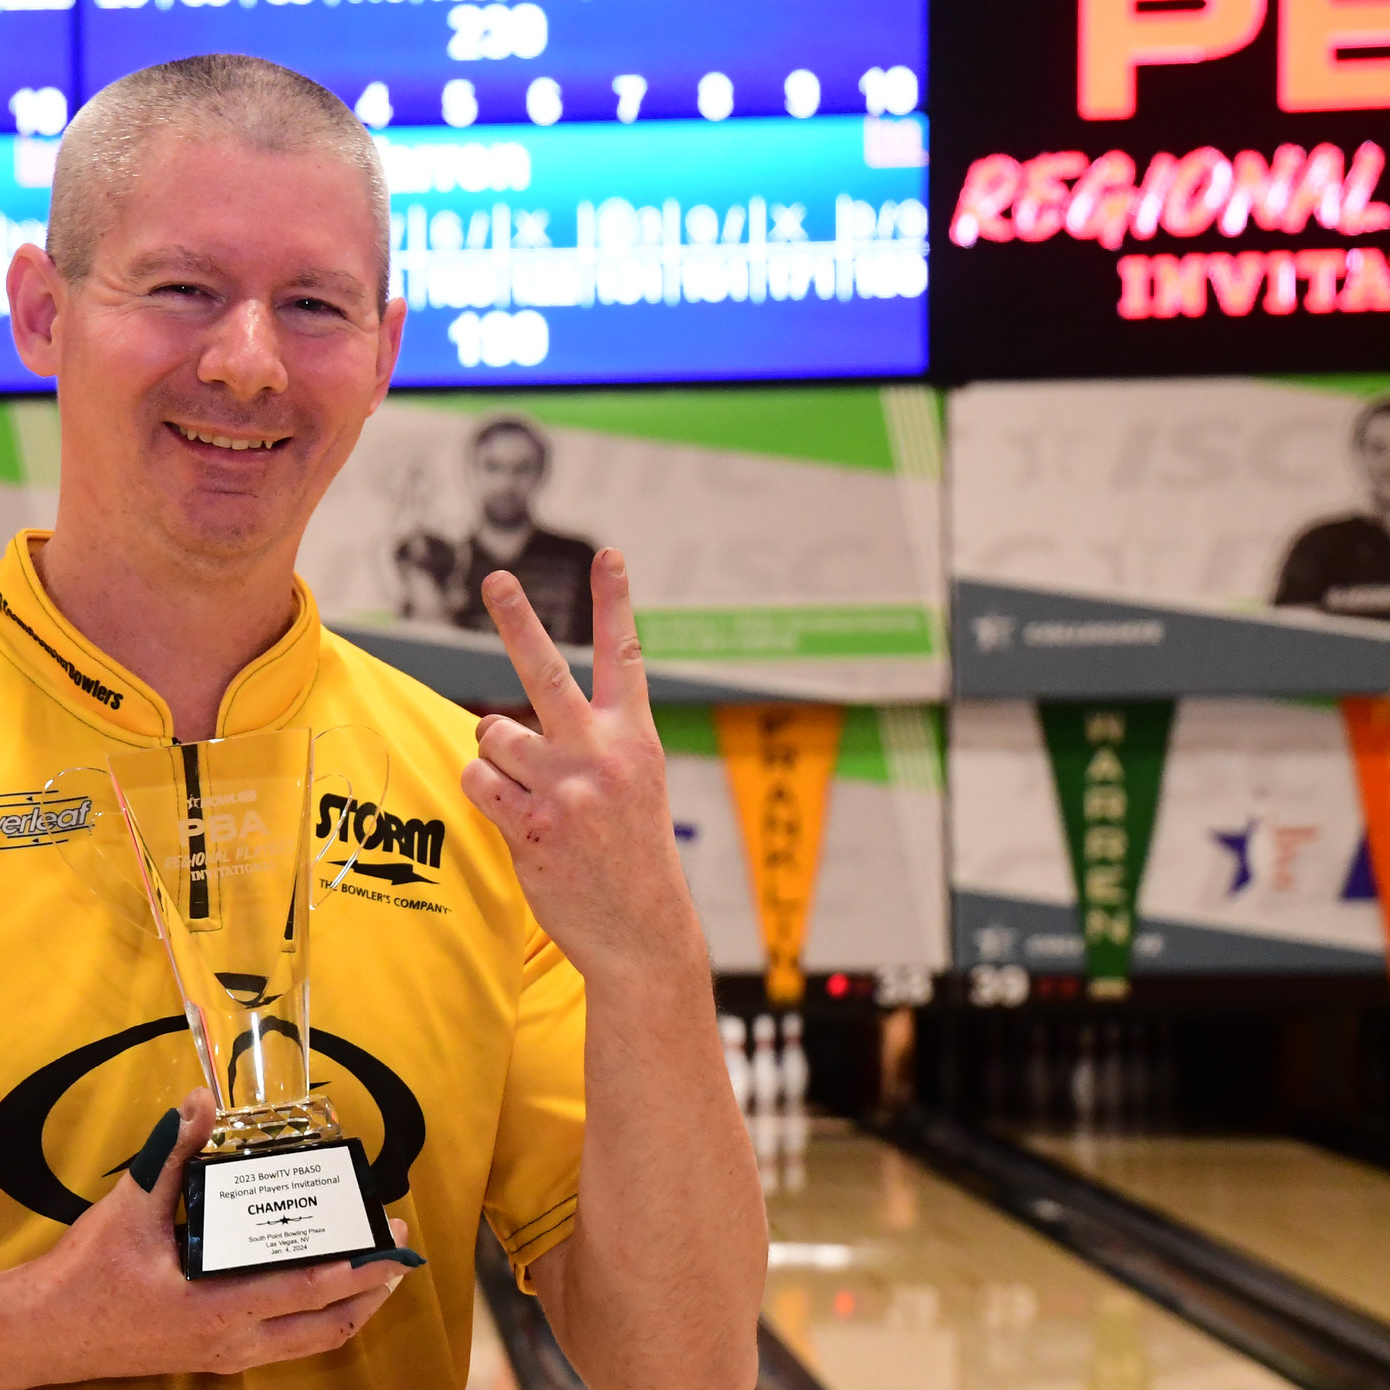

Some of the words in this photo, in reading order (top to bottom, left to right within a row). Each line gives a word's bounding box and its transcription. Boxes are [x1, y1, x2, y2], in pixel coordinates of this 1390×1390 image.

[613, 74, 647, 123] 7
[949, 141, 1390, 250] REGIONAL
[178, 809, 272, 849] PBA
[316, 793, 446, 869] STORM
[1083, 709, 1130, 946] HARREN
[341, 883, 391, 904] BOWLER'S
[393, 897, 449, 914] COMPANY
[219, 1187, 257, 1200] Regional
[259, 1183, 290, 1194] Players
[292, 1175, 341, 1189] Invitational
[234, 1174, 256, 1184] 2023
[258, 1169, 291, 1181] BowlTV
[292, 1164, 322, 1176] PBA50
[247, 1196, 318, 1215] CHAMPION
[248, 1235, 267, 1243] South
[267, 1233, 283, 1241] Point
[284, 1229, 308, 1239] Bowling
[292, 1244, 308, 1252] 2024
